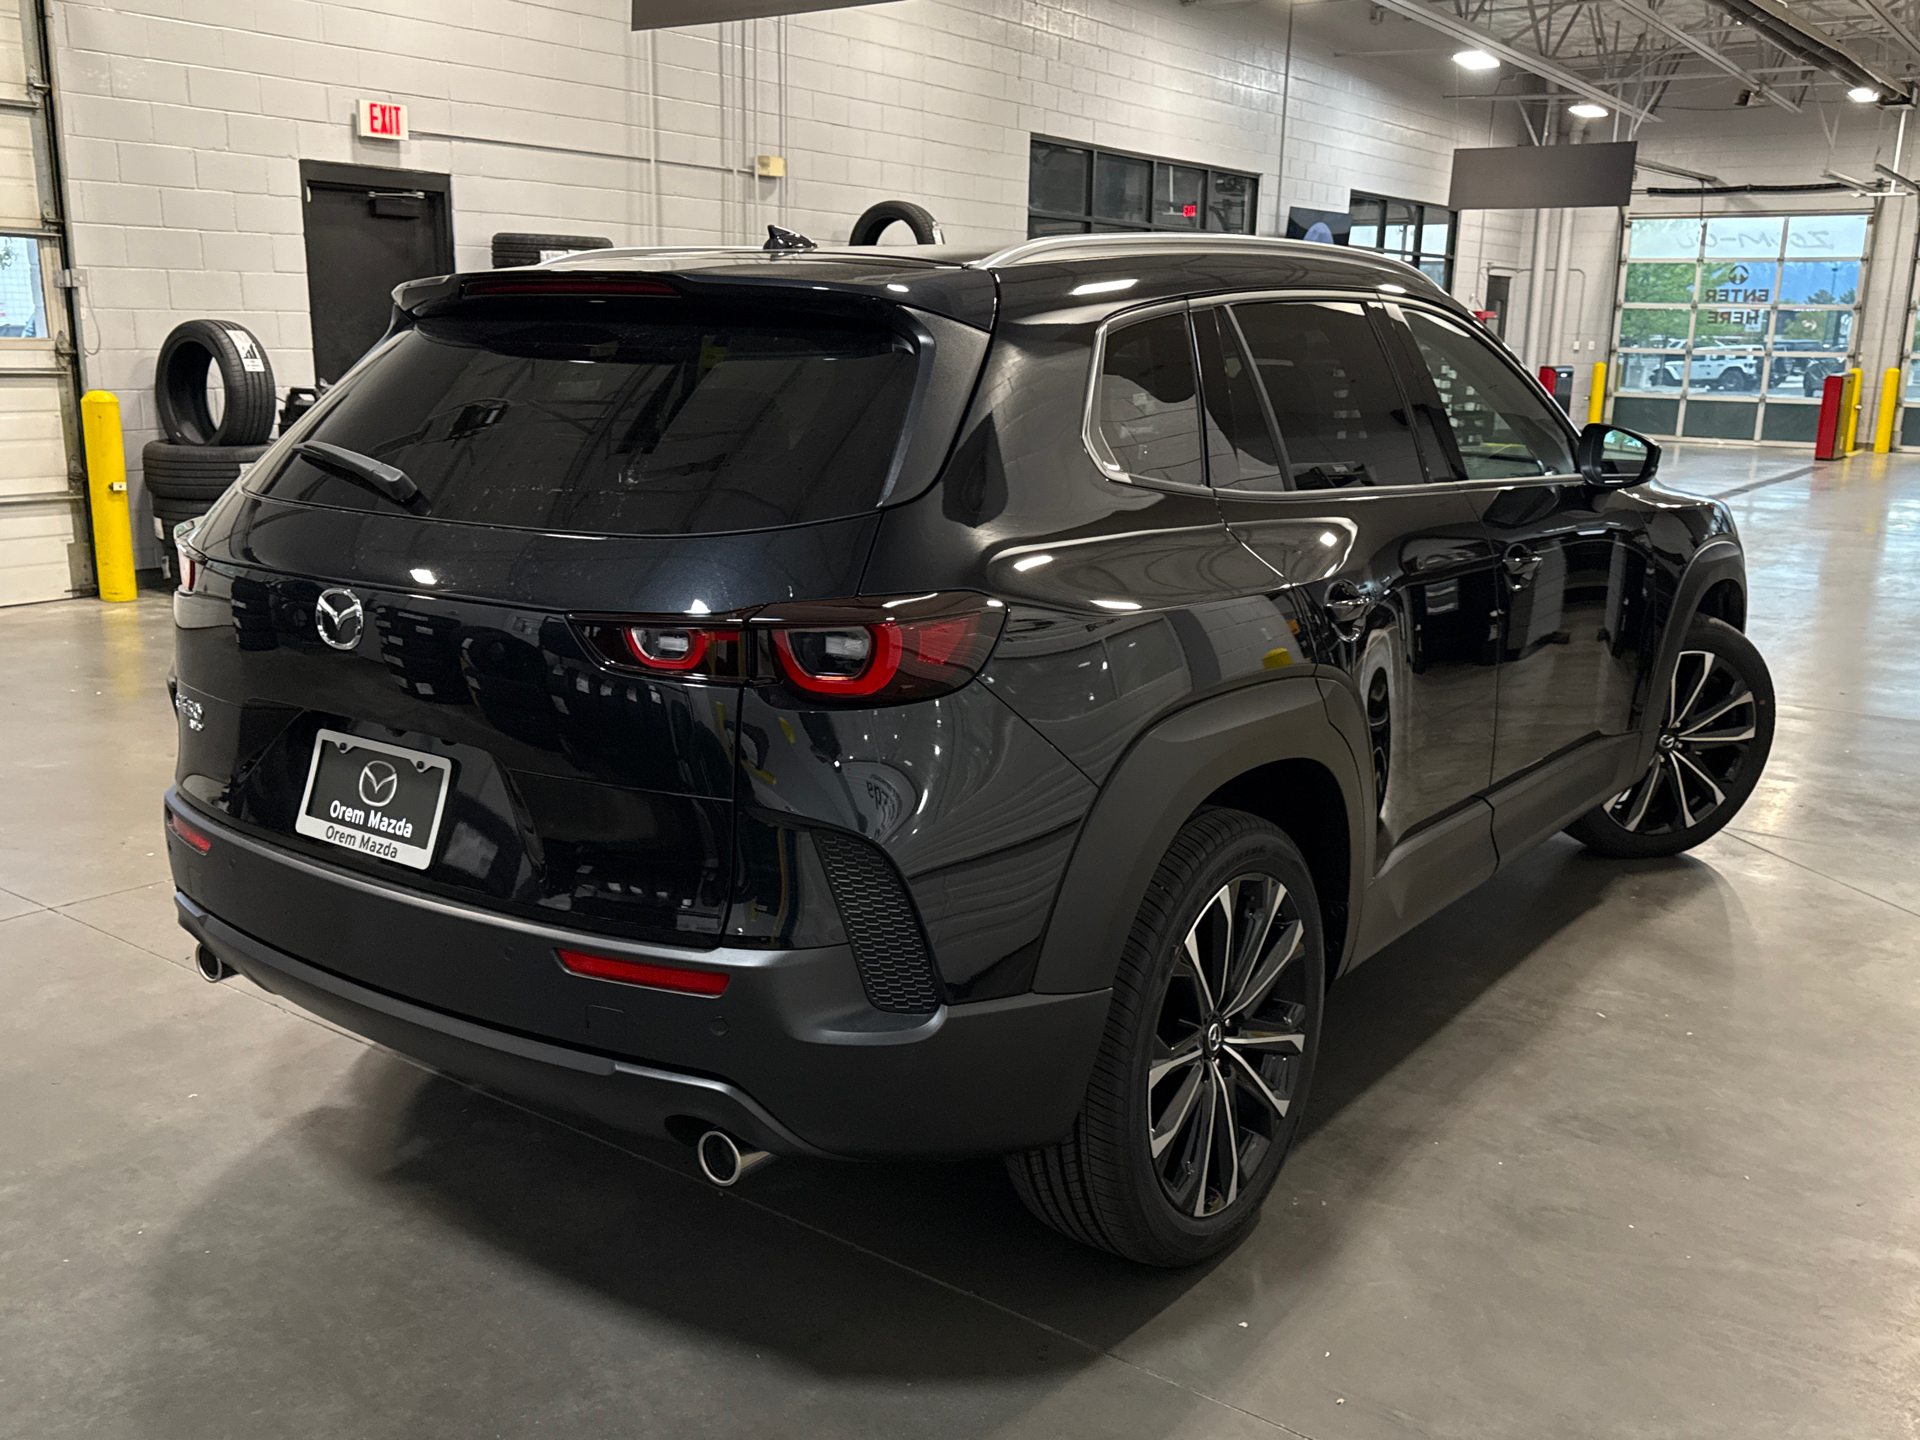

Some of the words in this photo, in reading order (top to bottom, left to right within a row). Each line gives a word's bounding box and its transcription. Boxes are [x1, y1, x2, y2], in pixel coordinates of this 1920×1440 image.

[369, 103, 401, 136] EXIT
[329, 800, 365, 826] Orem
[367, 810, 413, 838] Mazda
[325, 825, 357, 847] Orem
[358, 834, 398, 859] Mazda
